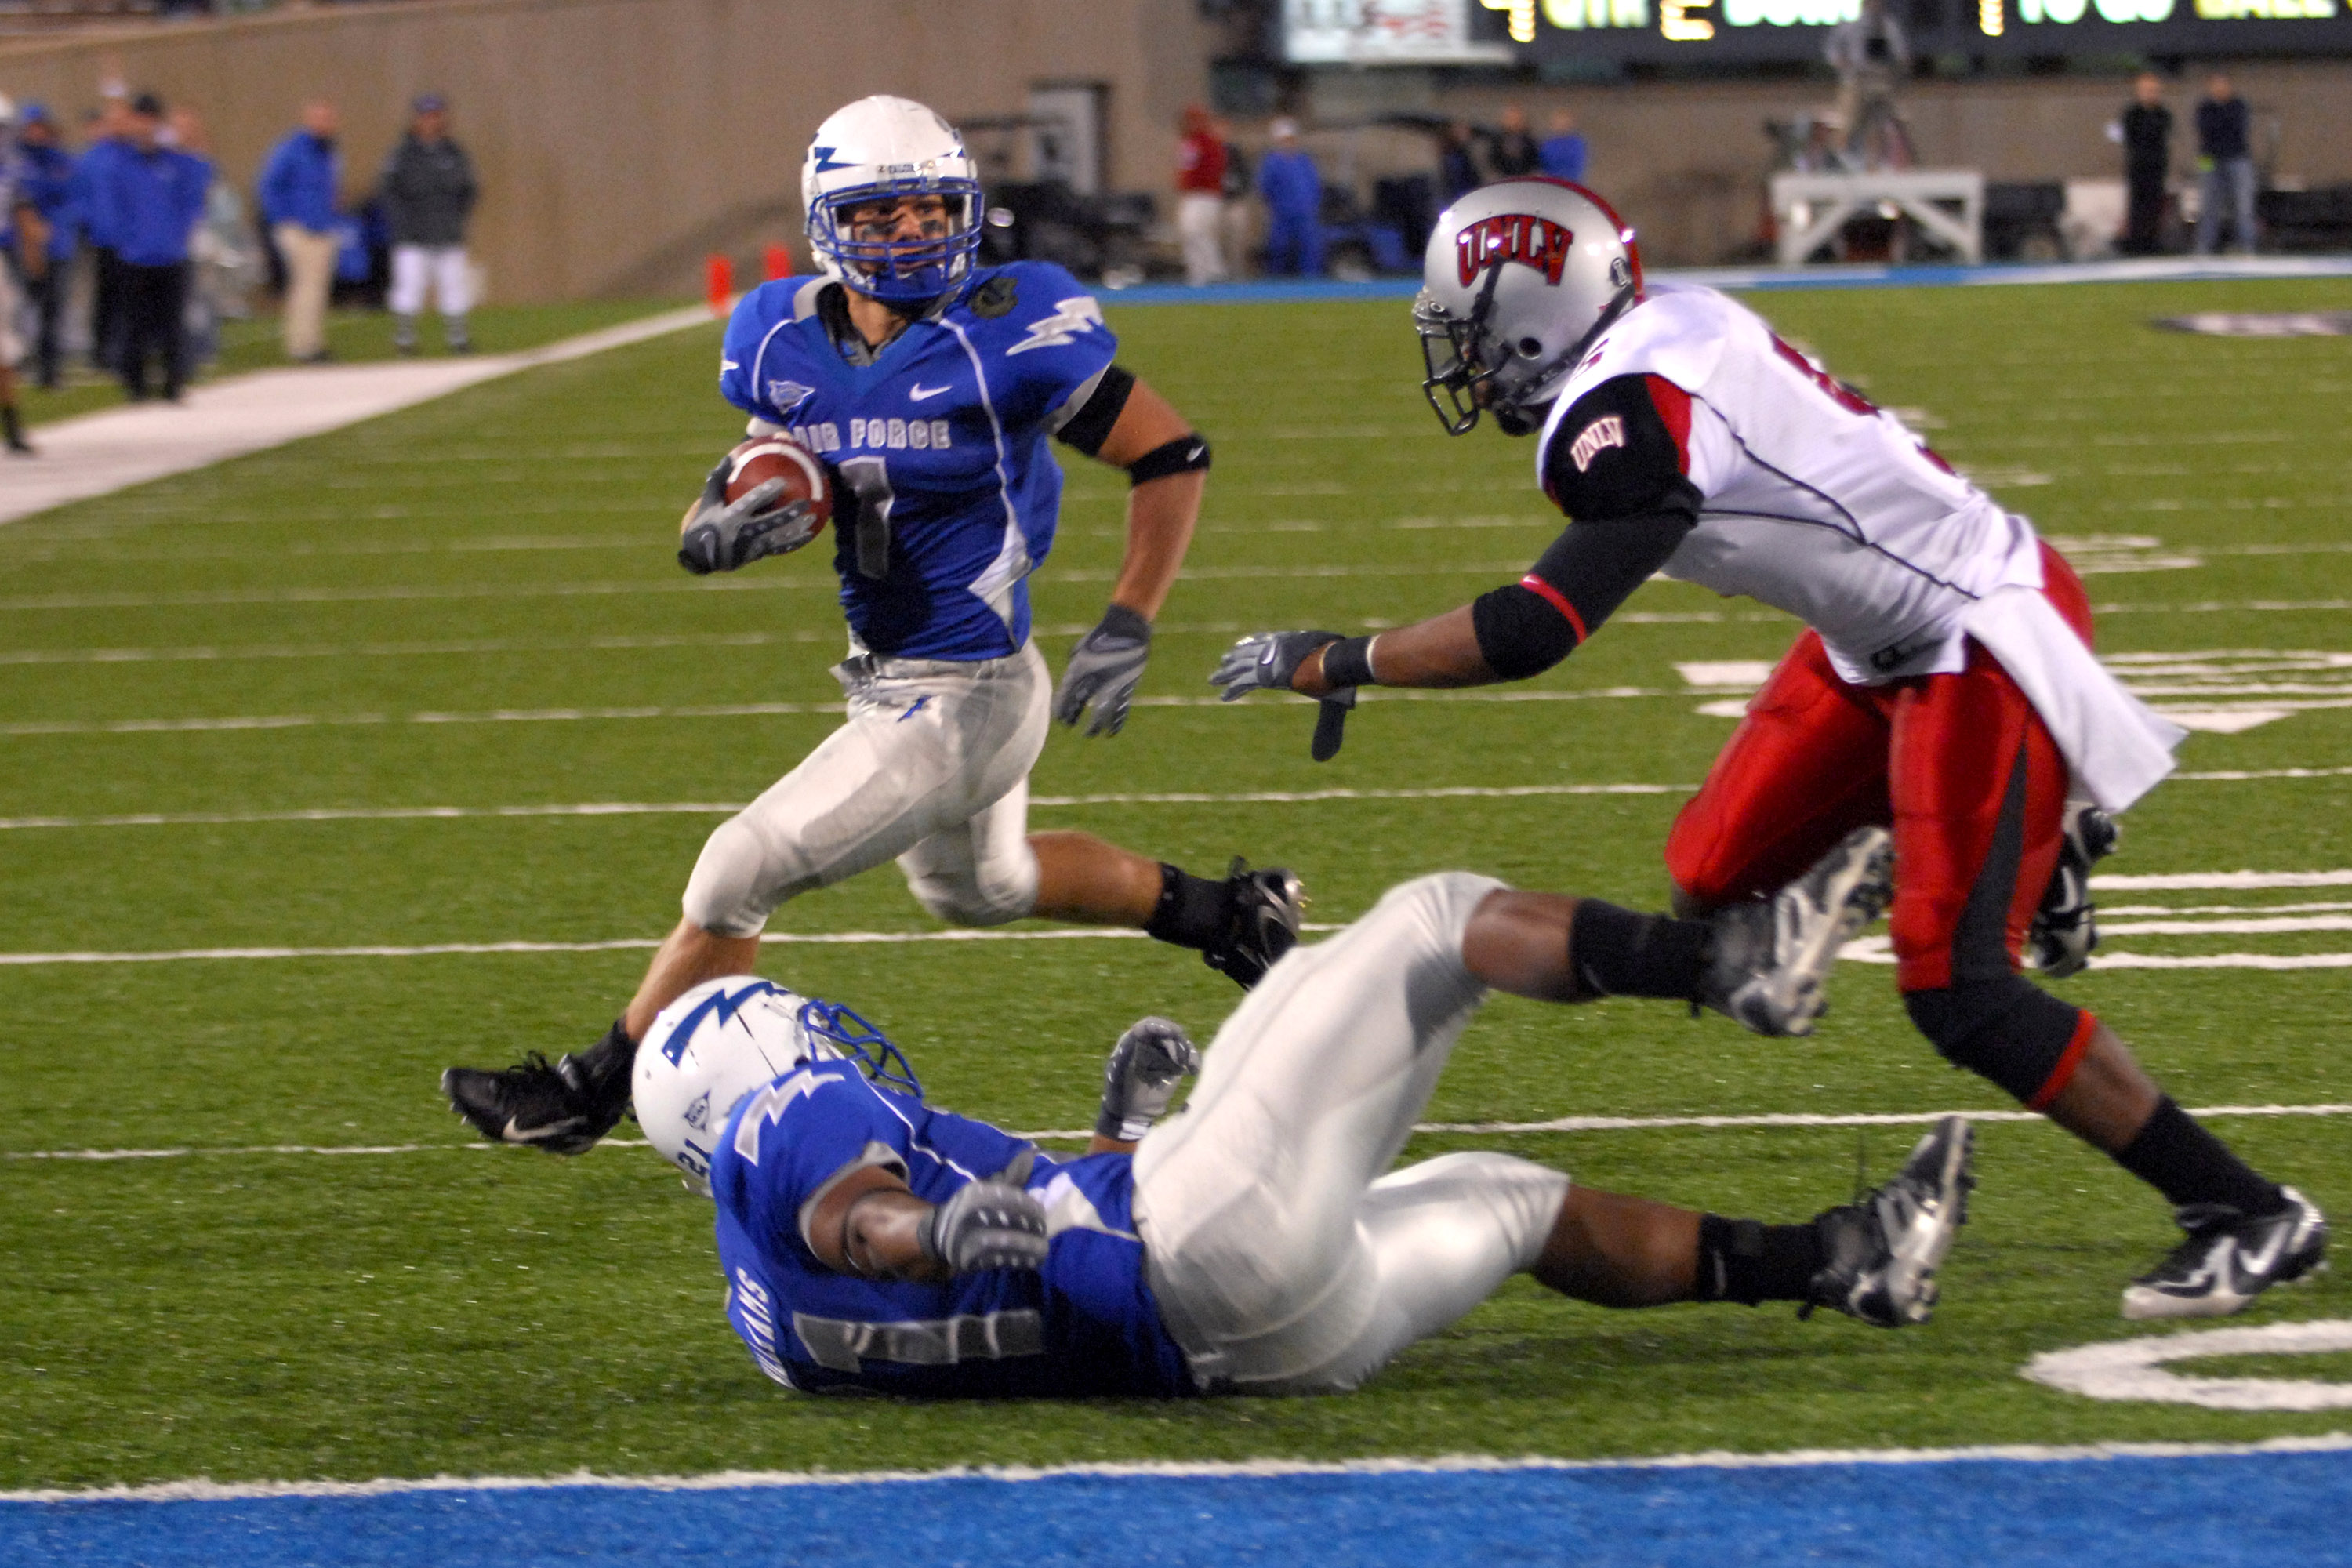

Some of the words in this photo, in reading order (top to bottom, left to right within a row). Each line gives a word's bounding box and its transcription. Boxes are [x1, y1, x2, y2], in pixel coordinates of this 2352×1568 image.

[1457, 216, 1574, 288] UNLV
[850, 417, 952, 450] FORCE
[1570, 416, 1625, 473] UNLV
[838, 456, 895, 579] 1
[677, 1138, 713, 1177] 21
